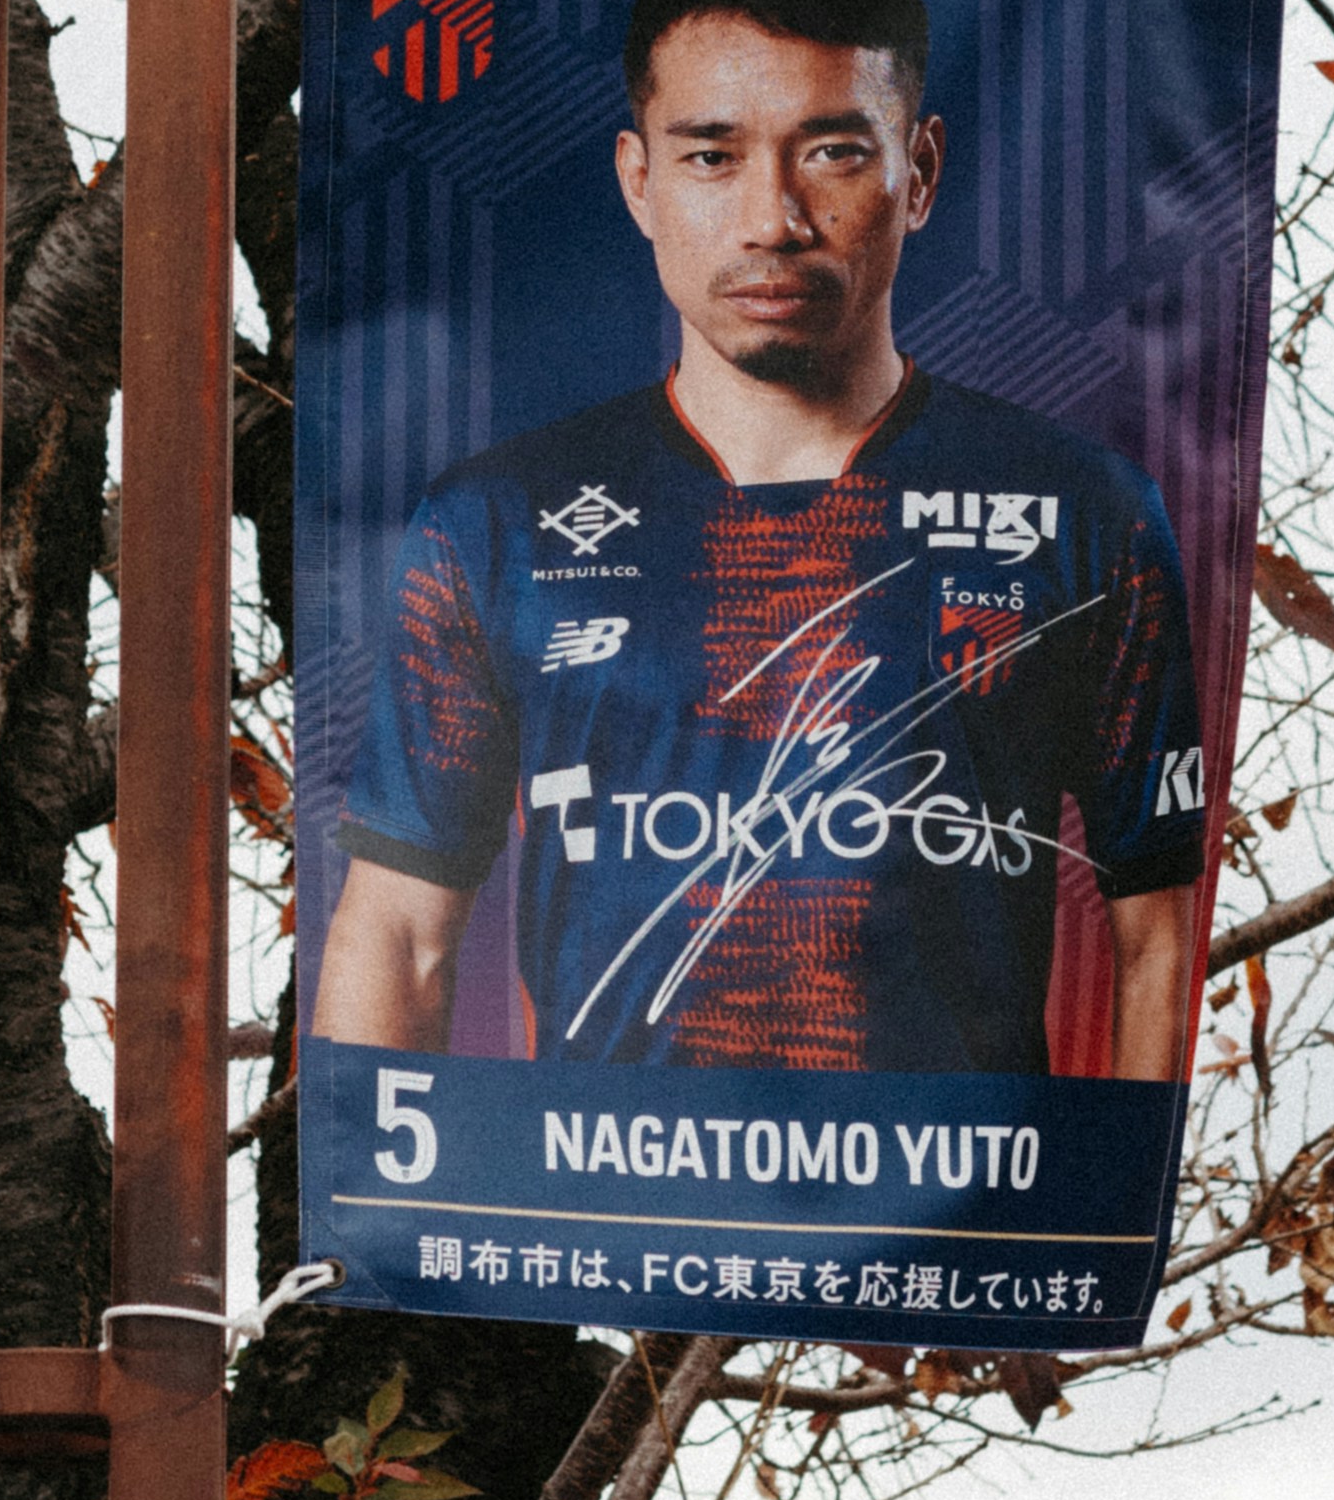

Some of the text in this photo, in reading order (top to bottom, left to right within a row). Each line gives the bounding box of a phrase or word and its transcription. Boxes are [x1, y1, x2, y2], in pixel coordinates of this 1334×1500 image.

[942, 576, 1024, 596] F C
[942, 591, 1025, 611] TOKYO
[611, 790, 1032, 876] TOKYO GAS
[374, 1067, 439, 1185] 5
[544, 1110, 1040, 1191] NAGATOMO YUTO
[417, 1234, 1104, 1315] 調布市は、FC東京を応援しています。
